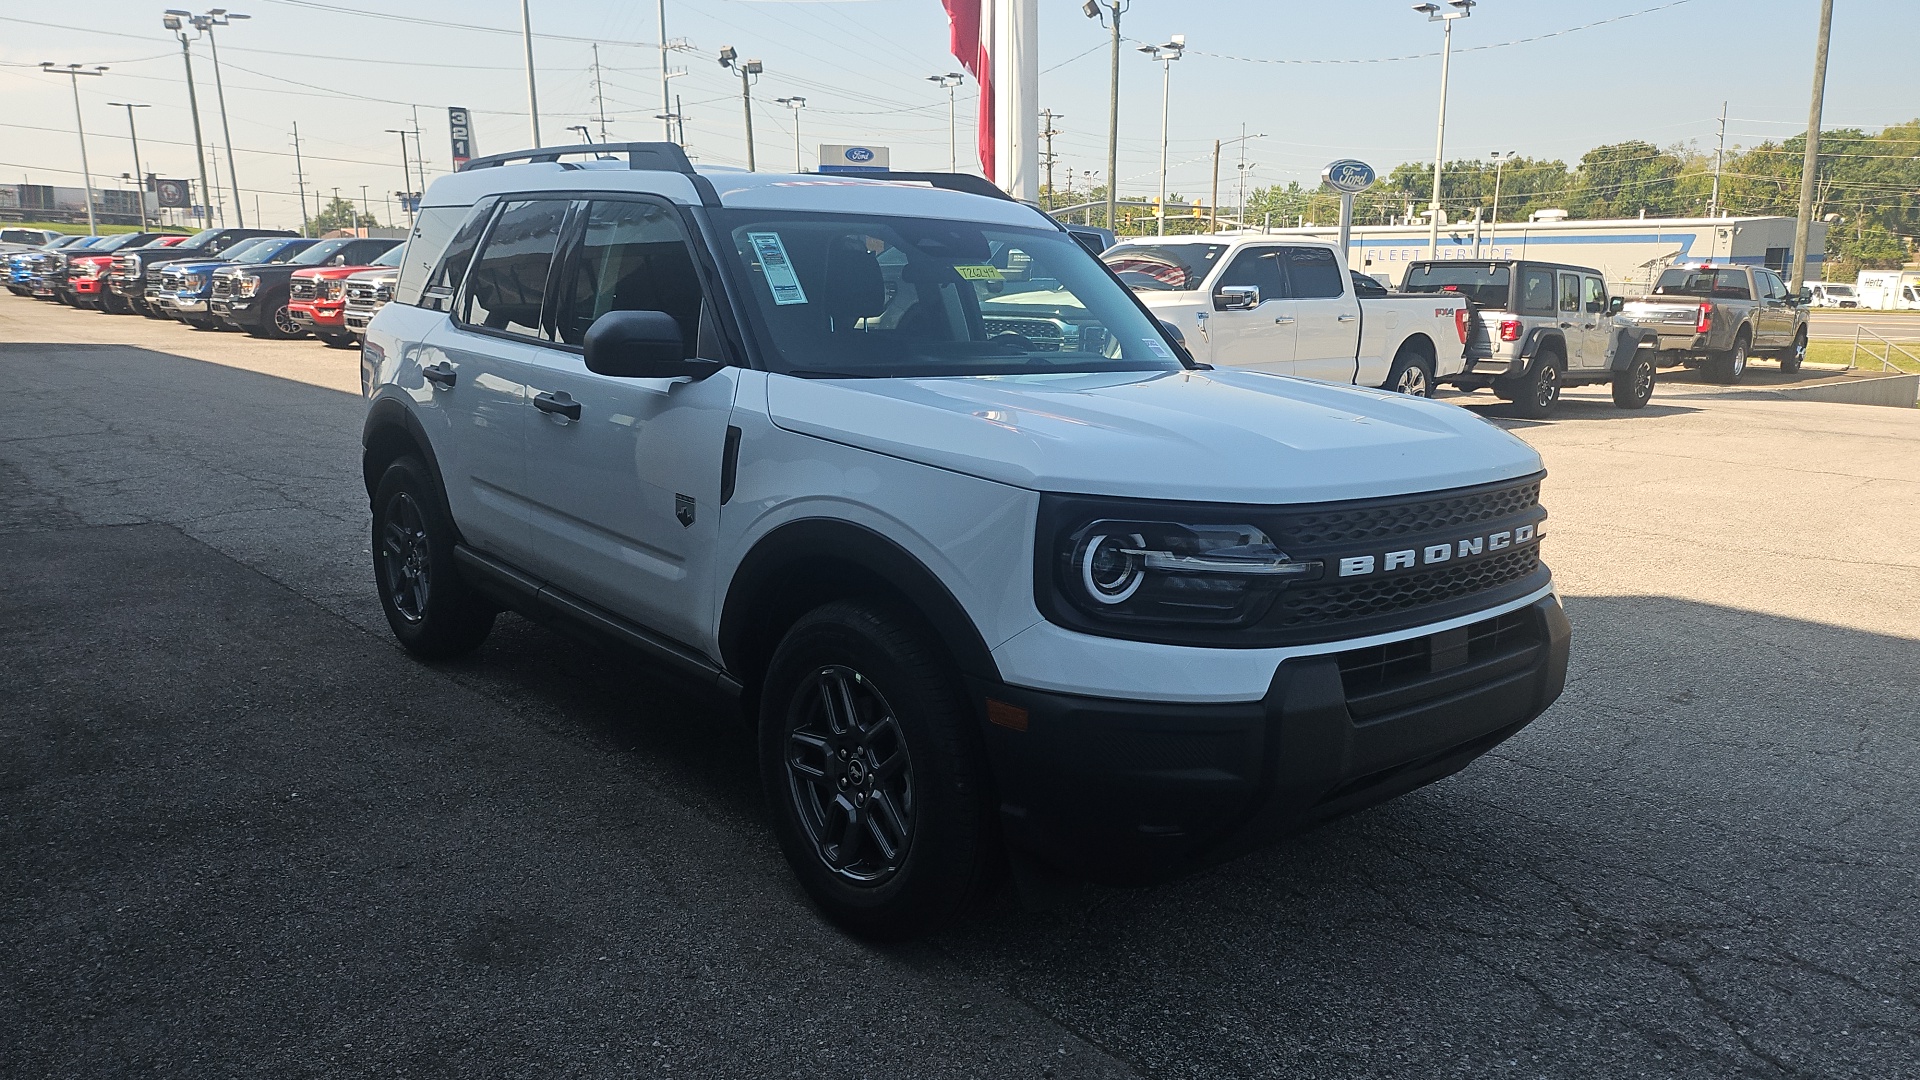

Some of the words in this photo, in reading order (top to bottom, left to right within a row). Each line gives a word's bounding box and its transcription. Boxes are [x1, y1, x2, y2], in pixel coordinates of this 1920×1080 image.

[851, 150, 870, 161] Ford
[1339, 165, 1368, 186] Ford
[1367, 249, 1422, 261] FLEET
[1864, 278, 1883, 287] Hertz
[1435, 308, 1454, 317] FX4
[1339, 525, 1533, 577] BRONCO
